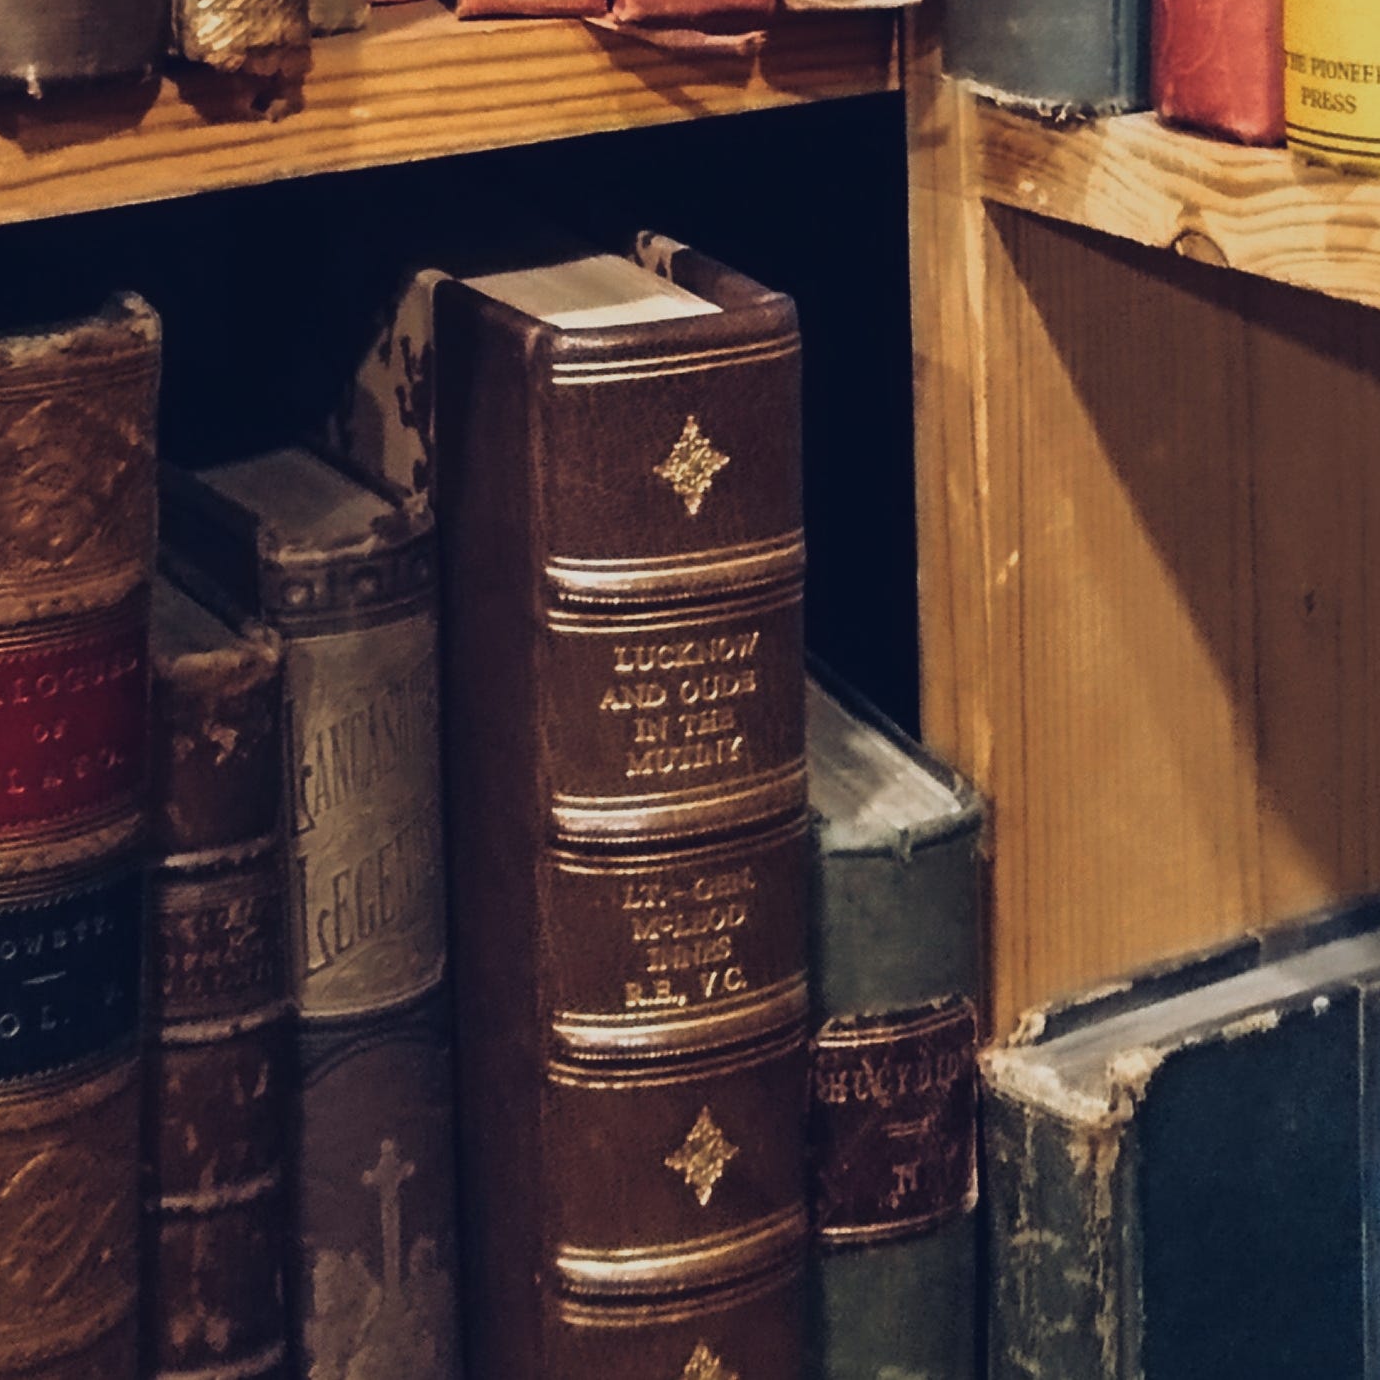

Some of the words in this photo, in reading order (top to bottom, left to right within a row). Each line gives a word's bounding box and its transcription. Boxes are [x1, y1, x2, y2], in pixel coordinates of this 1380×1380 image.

[1301, 88, 1357, 115] PRESS
[614, 631, 760, 671] LUCKNOW
[599, 684, 666, 710] AND
[679, 670, 757, 704] OUDE
[635, 717, 668, 742] IN
[678, 706, 735, 737] THE
